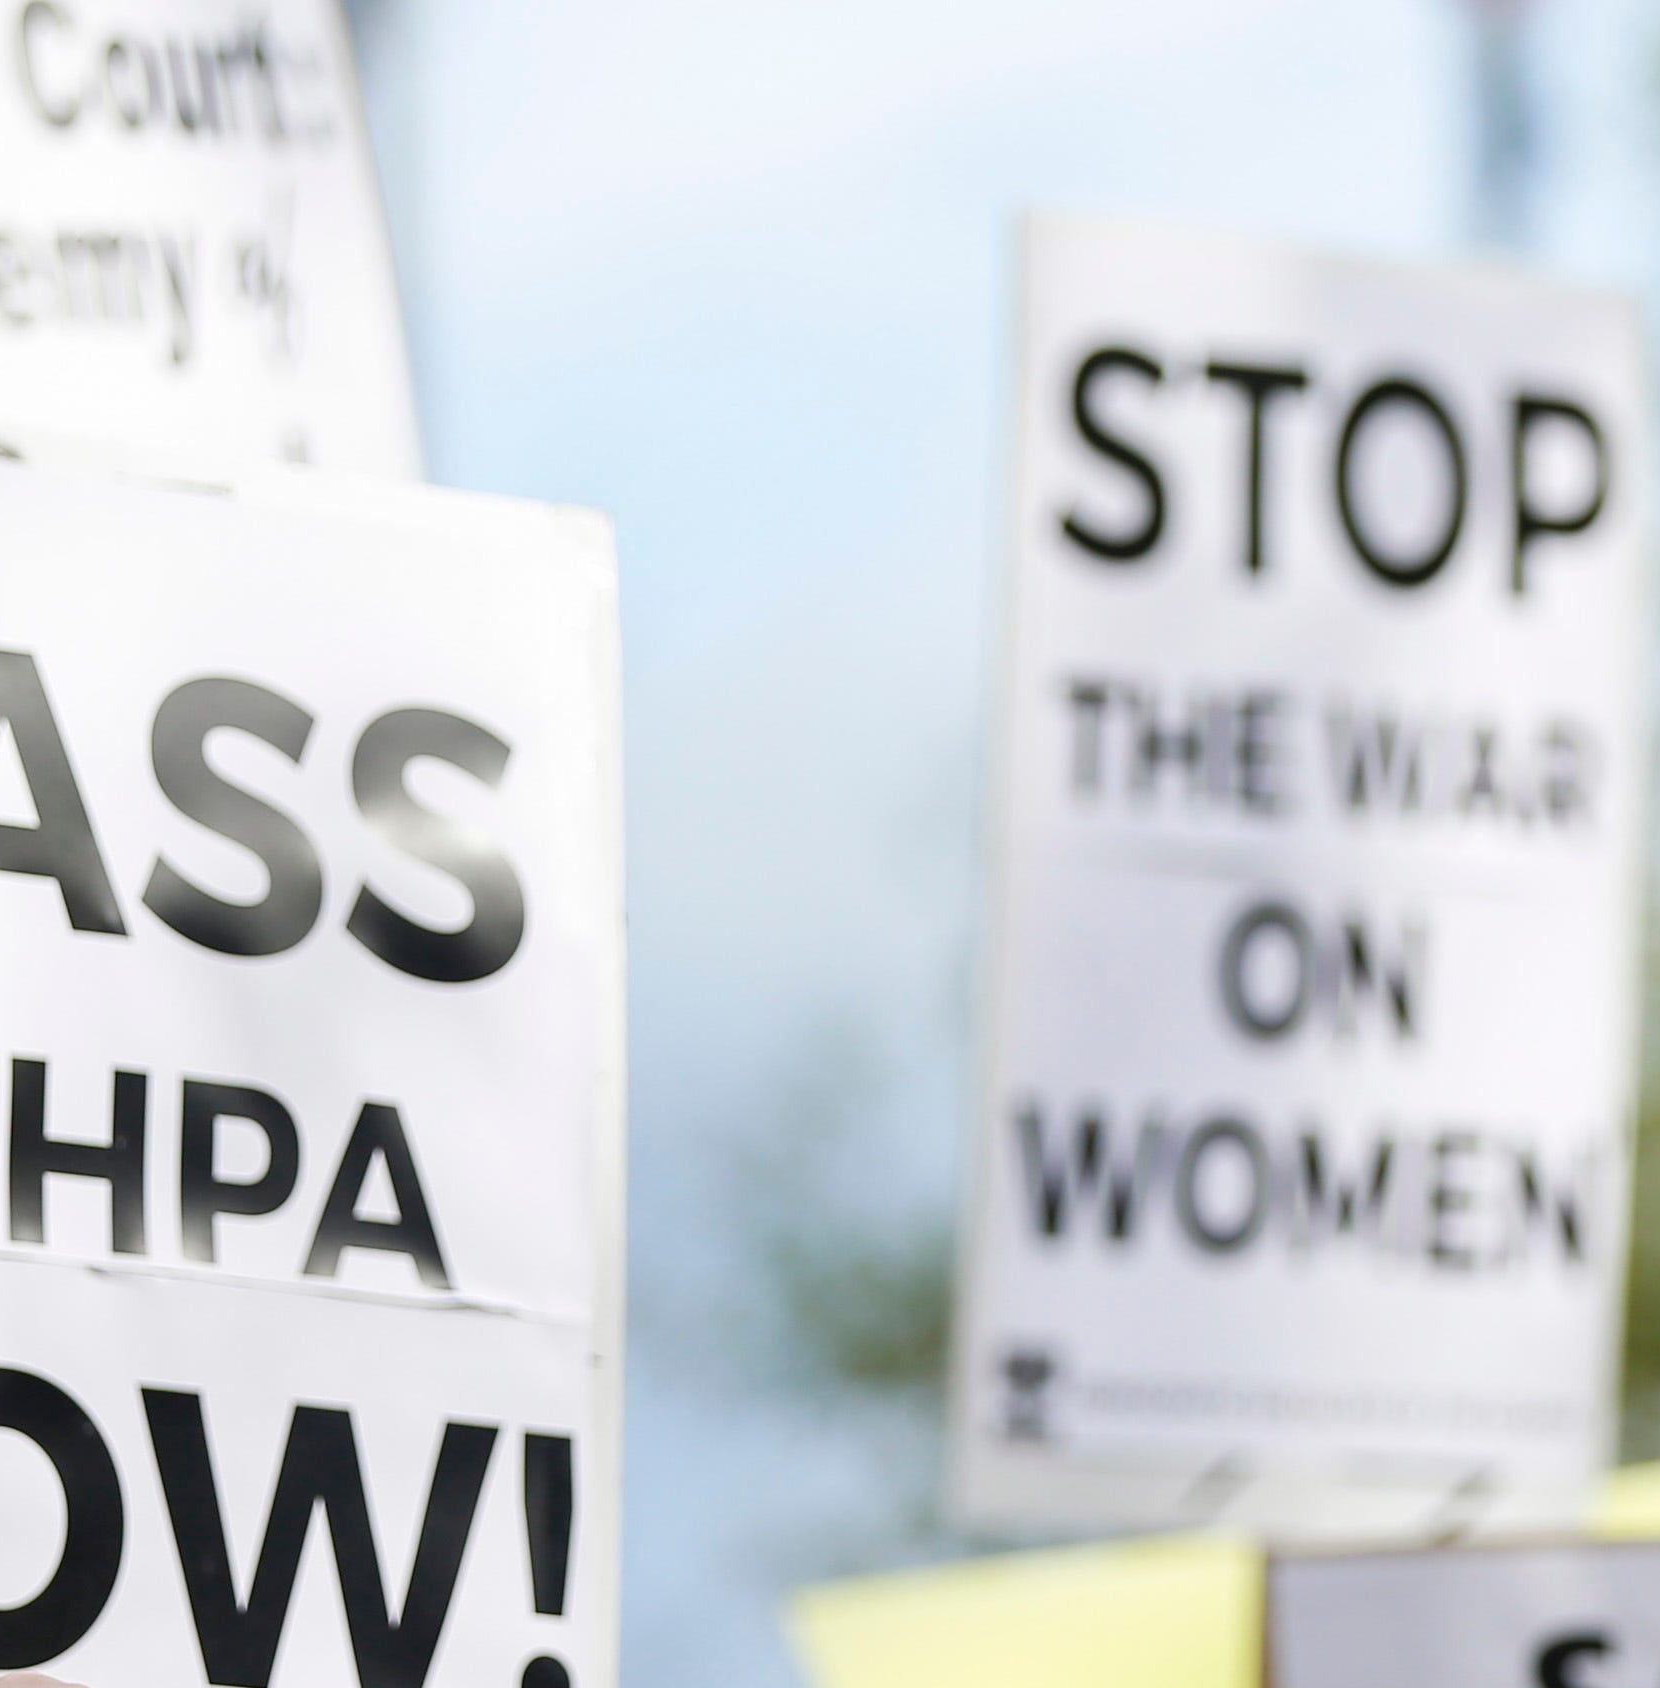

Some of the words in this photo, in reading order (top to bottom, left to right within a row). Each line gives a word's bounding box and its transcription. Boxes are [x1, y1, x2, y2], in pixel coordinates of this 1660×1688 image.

[1061, 346, 1607, 594] STOP
[1066, 680, 1286, 818] THE
[1323, 702, 1595, 828] WAR
[1217, 894, 1423, 1048] ON
[1011, 1099, 1594, 1268] WOMEN
